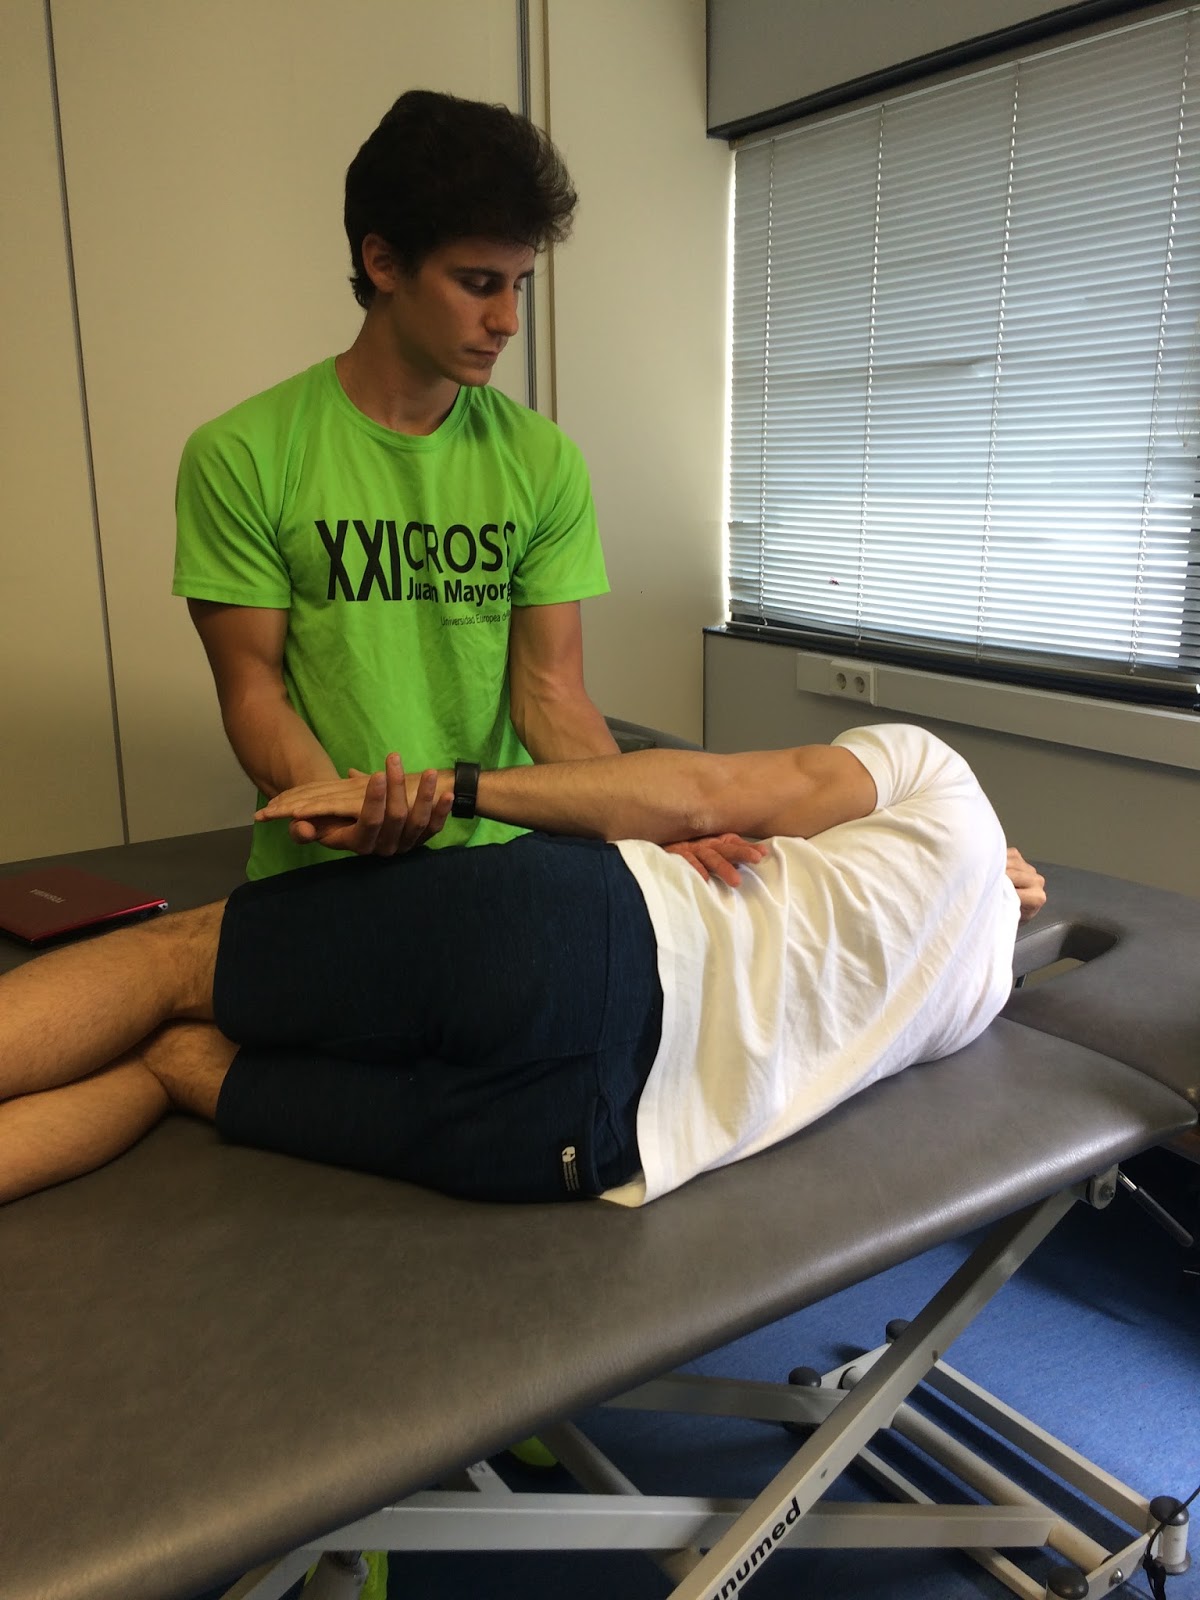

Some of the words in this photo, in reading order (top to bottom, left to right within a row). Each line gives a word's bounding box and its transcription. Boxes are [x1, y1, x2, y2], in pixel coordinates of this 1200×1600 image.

[314, 519, 402, 602] XXI
[406, 577, 439, 603] Juan
[440, 615, 476, 626] Universidad
[475, 613, 501, 624] Europea
